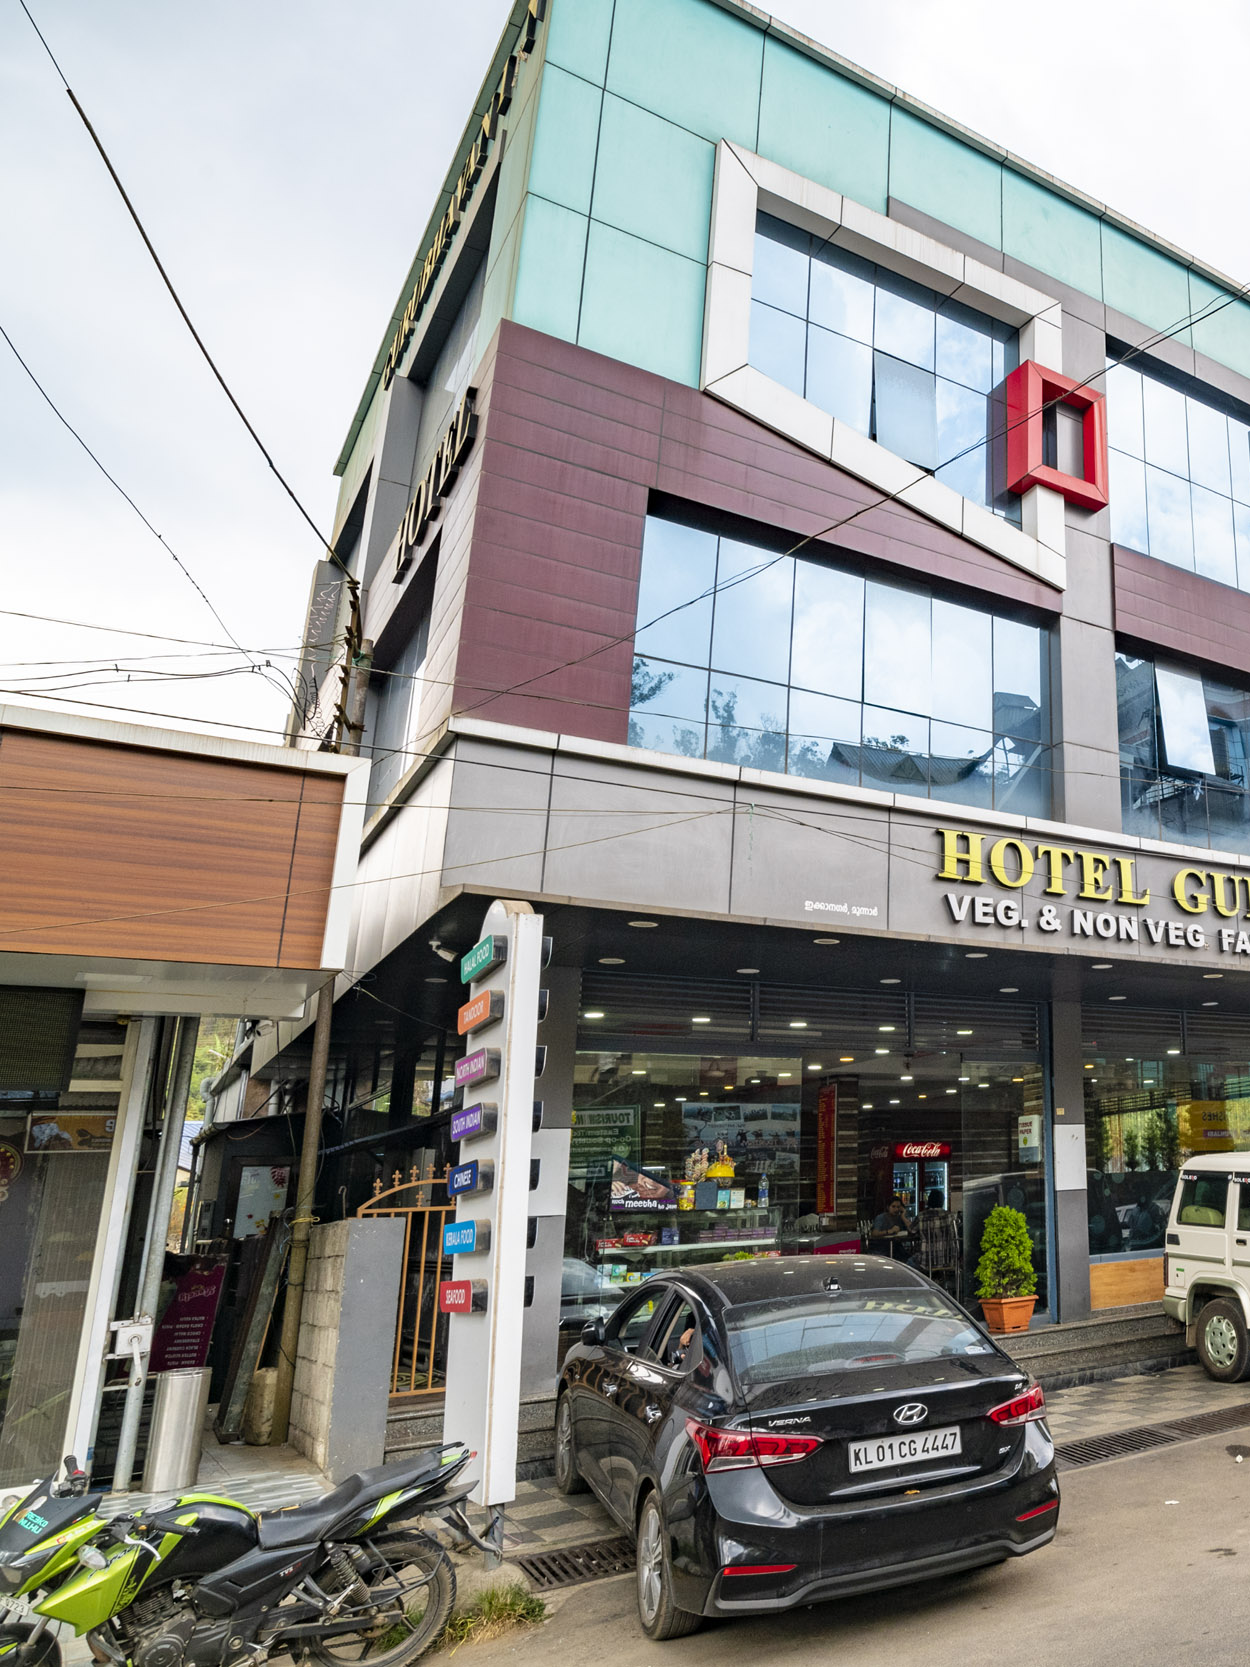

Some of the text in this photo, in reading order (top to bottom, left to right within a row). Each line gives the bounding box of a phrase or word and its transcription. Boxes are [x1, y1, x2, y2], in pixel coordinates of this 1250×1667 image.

[394, 390, 475, 575] HOTEL
[936, 828, 1151, 906] HOTEL
[946, 893, 1030, 928] VEG.
[1038, 904, 1062, 932] &
[1072, 910, 1139, 940] NON
[463, 943, 490, 976] HALAL FOOD
[463, 1000, 484, 1025] TANDOOR
[452, 1111, 481, 1135] SOUTH INDIAN
[902, 1141, 942, 1158] Coca-Cola
[453, 1169, 472, 1189] CHINESE
[445, 1228, 474, 1247] KERALA FOOD
[445, 1288, 466, 1305] SEAFOOD
[767, 1415, 812, 1427] VERNA
[852, 1431, 958, 1468] KL 01 CG 4447
